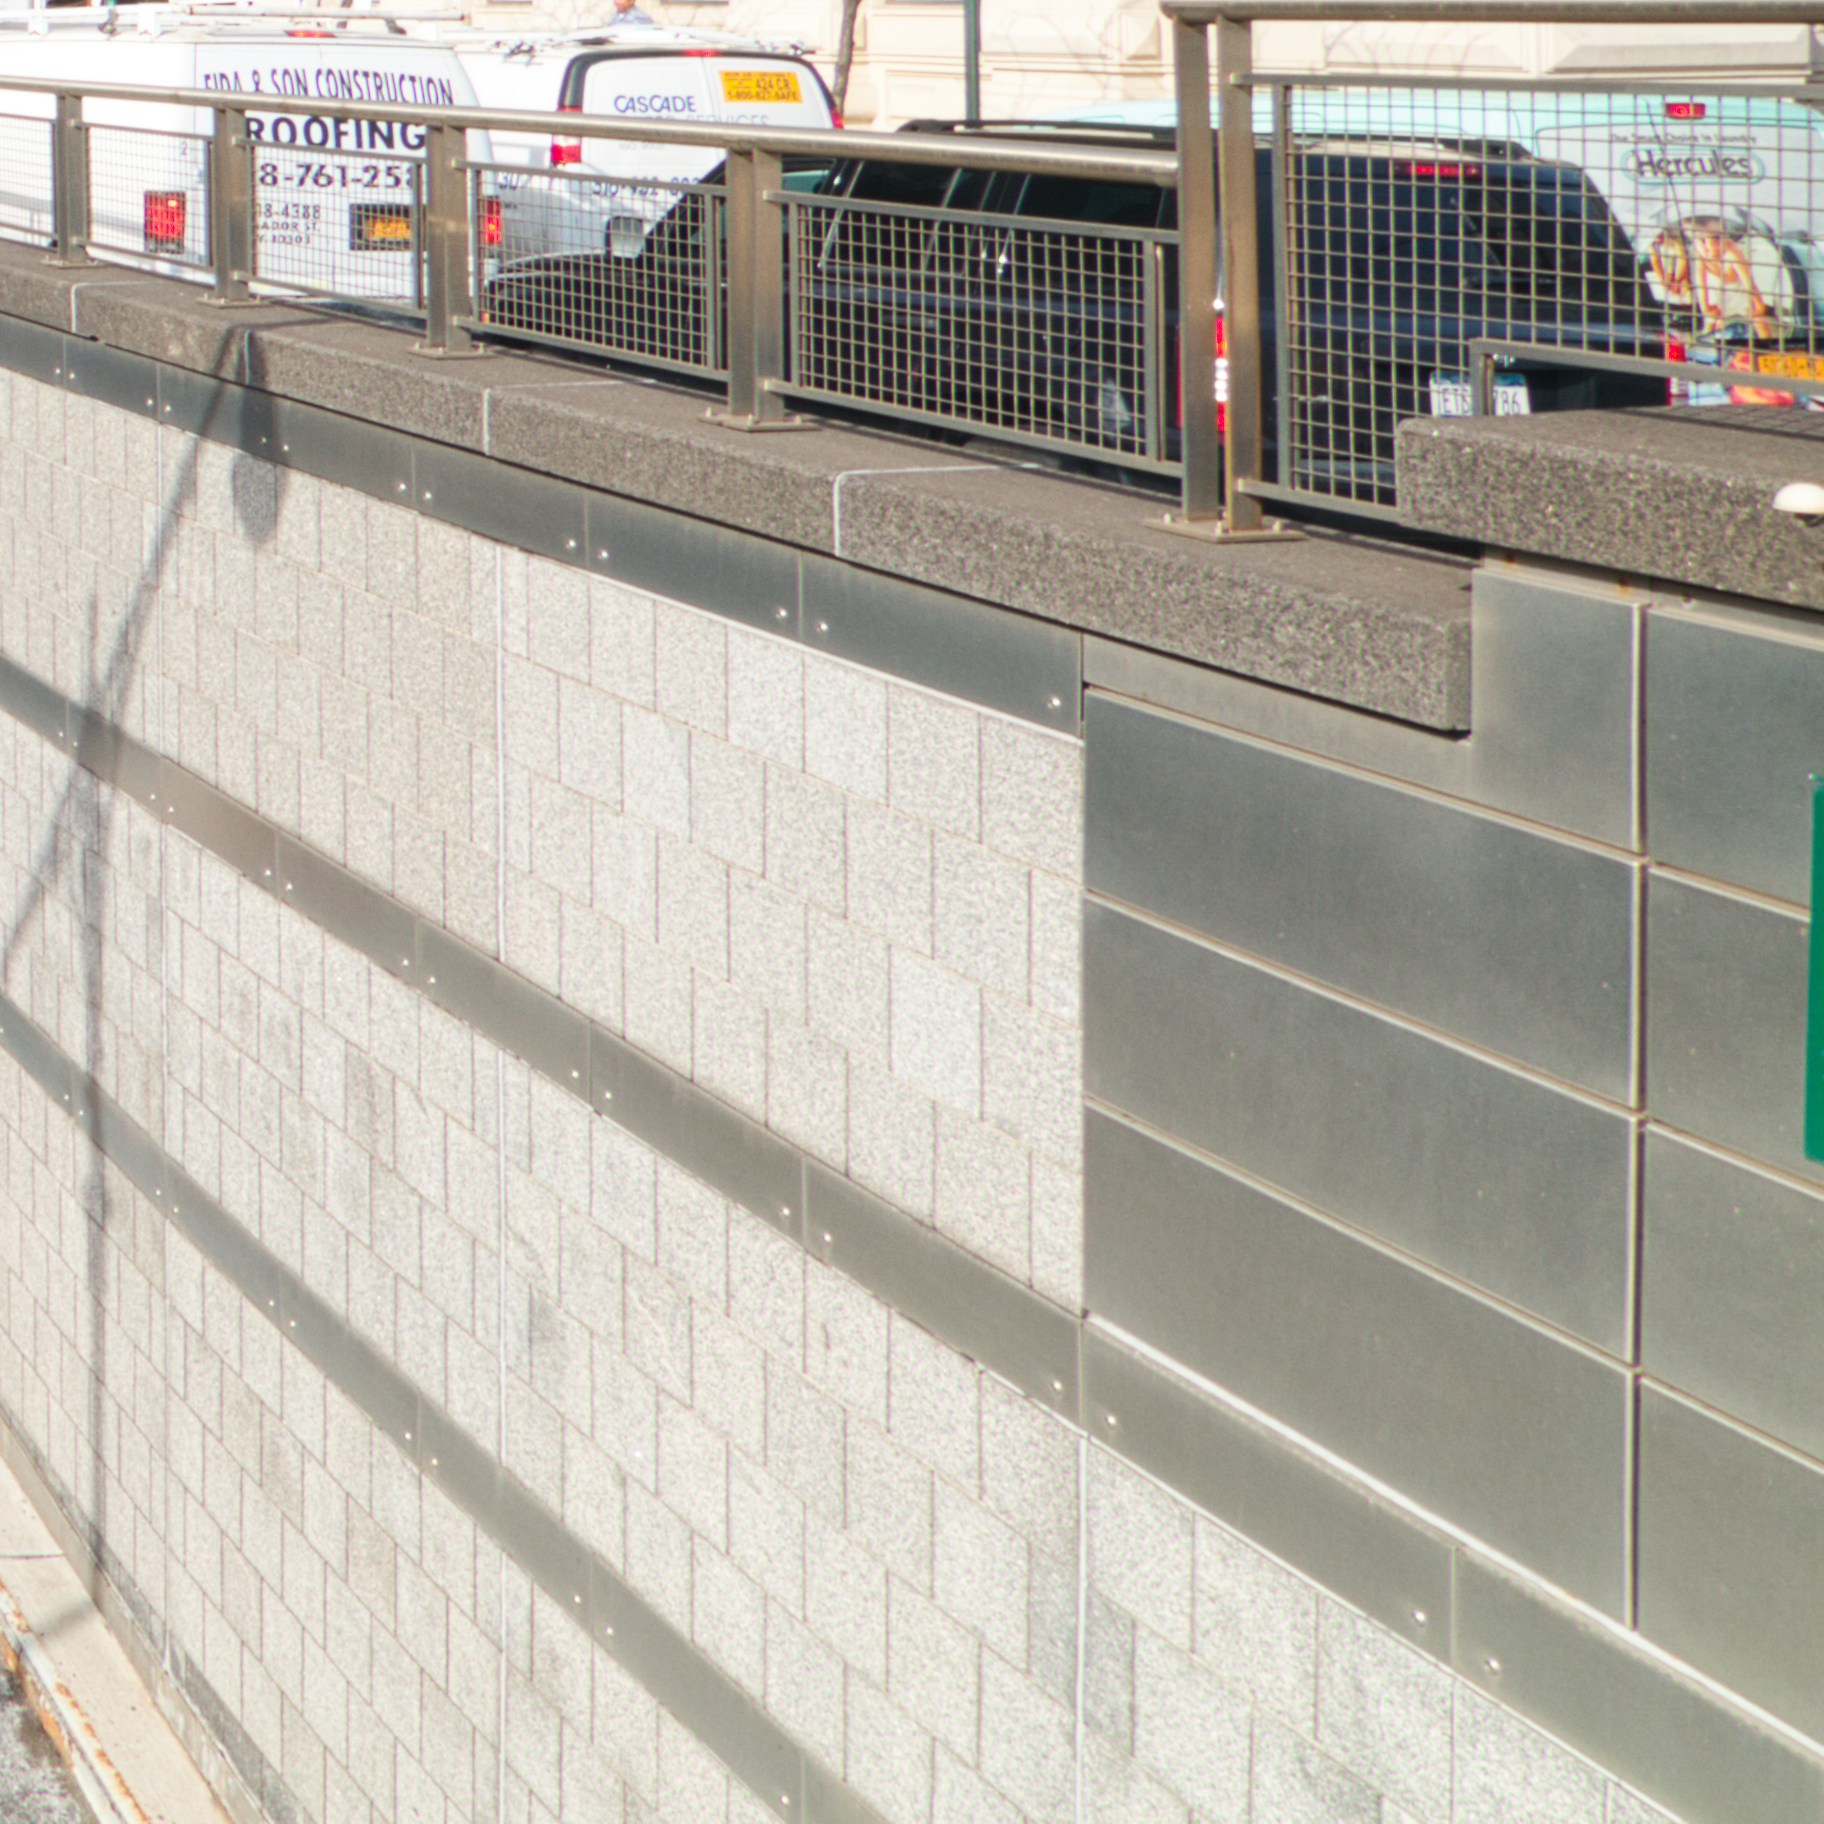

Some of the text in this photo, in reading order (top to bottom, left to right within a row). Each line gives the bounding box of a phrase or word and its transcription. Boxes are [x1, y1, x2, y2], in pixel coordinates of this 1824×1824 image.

[270, 68, 309, 97] SON
[315, 68, 454, 106] CONSTRUCTION
[614, 94, 697, 114] CASCADE
[245, 115, 426, 150] ROOFING
[1631, 149, 1752, 177] Hercules
